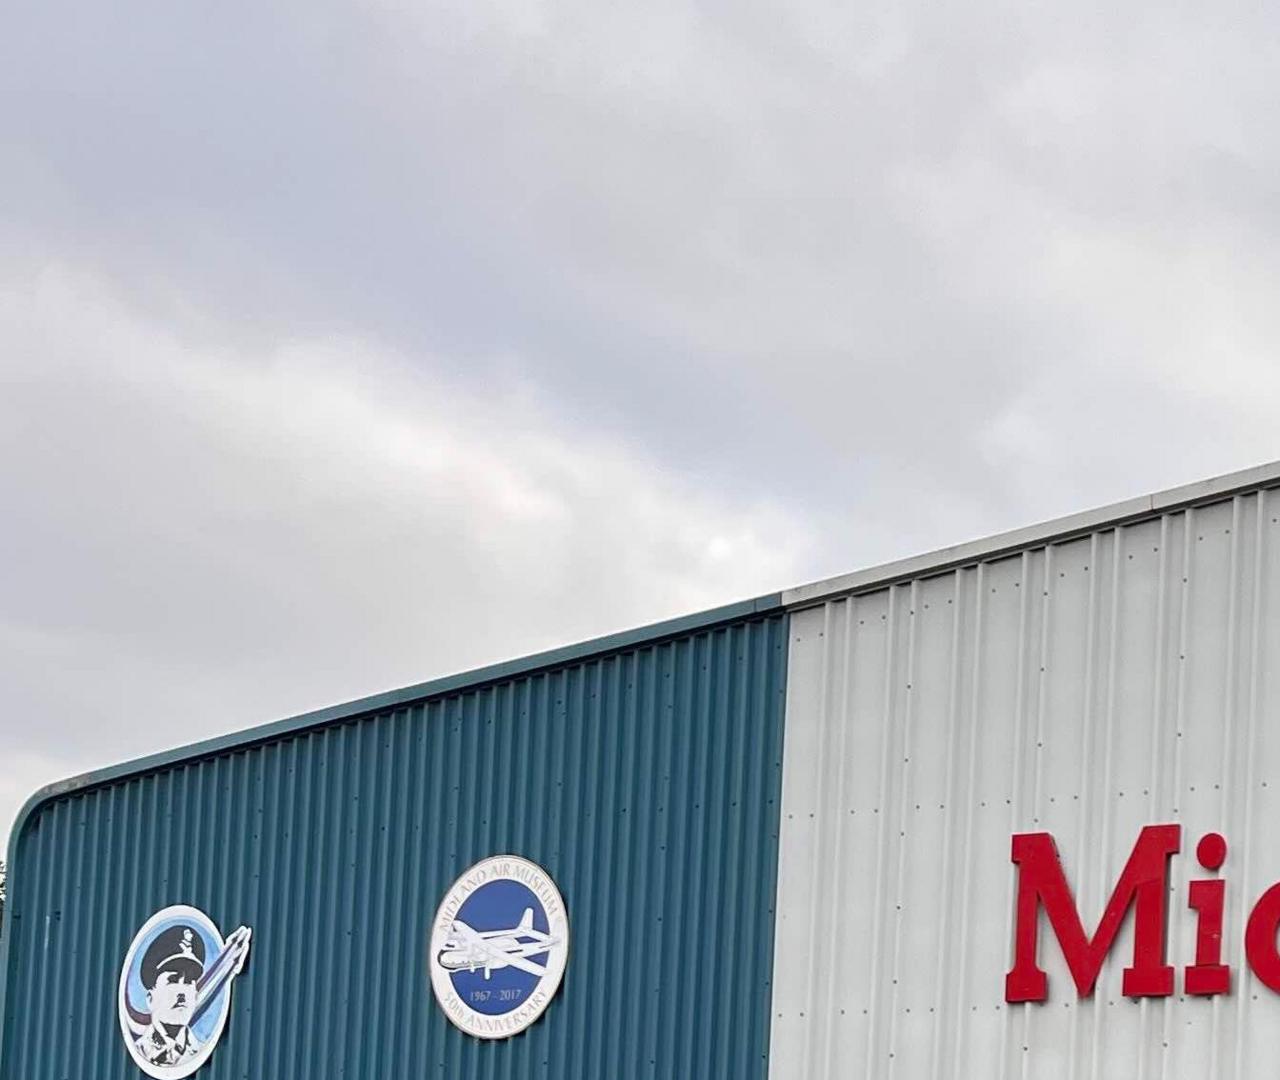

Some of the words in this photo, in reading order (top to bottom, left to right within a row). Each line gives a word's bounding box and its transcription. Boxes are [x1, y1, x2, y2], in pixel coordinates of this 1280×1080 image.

[440, 869, 487, 930] MIDLAND
[491, 863, 511, 877] AIR
[514, 865, 558, 916] MUSEUM
[466, 991, 547, 1032] ANNIVERSARY
[470, 990, 491, 1001] 1967
[500, 989, 522, 1001] 2017
